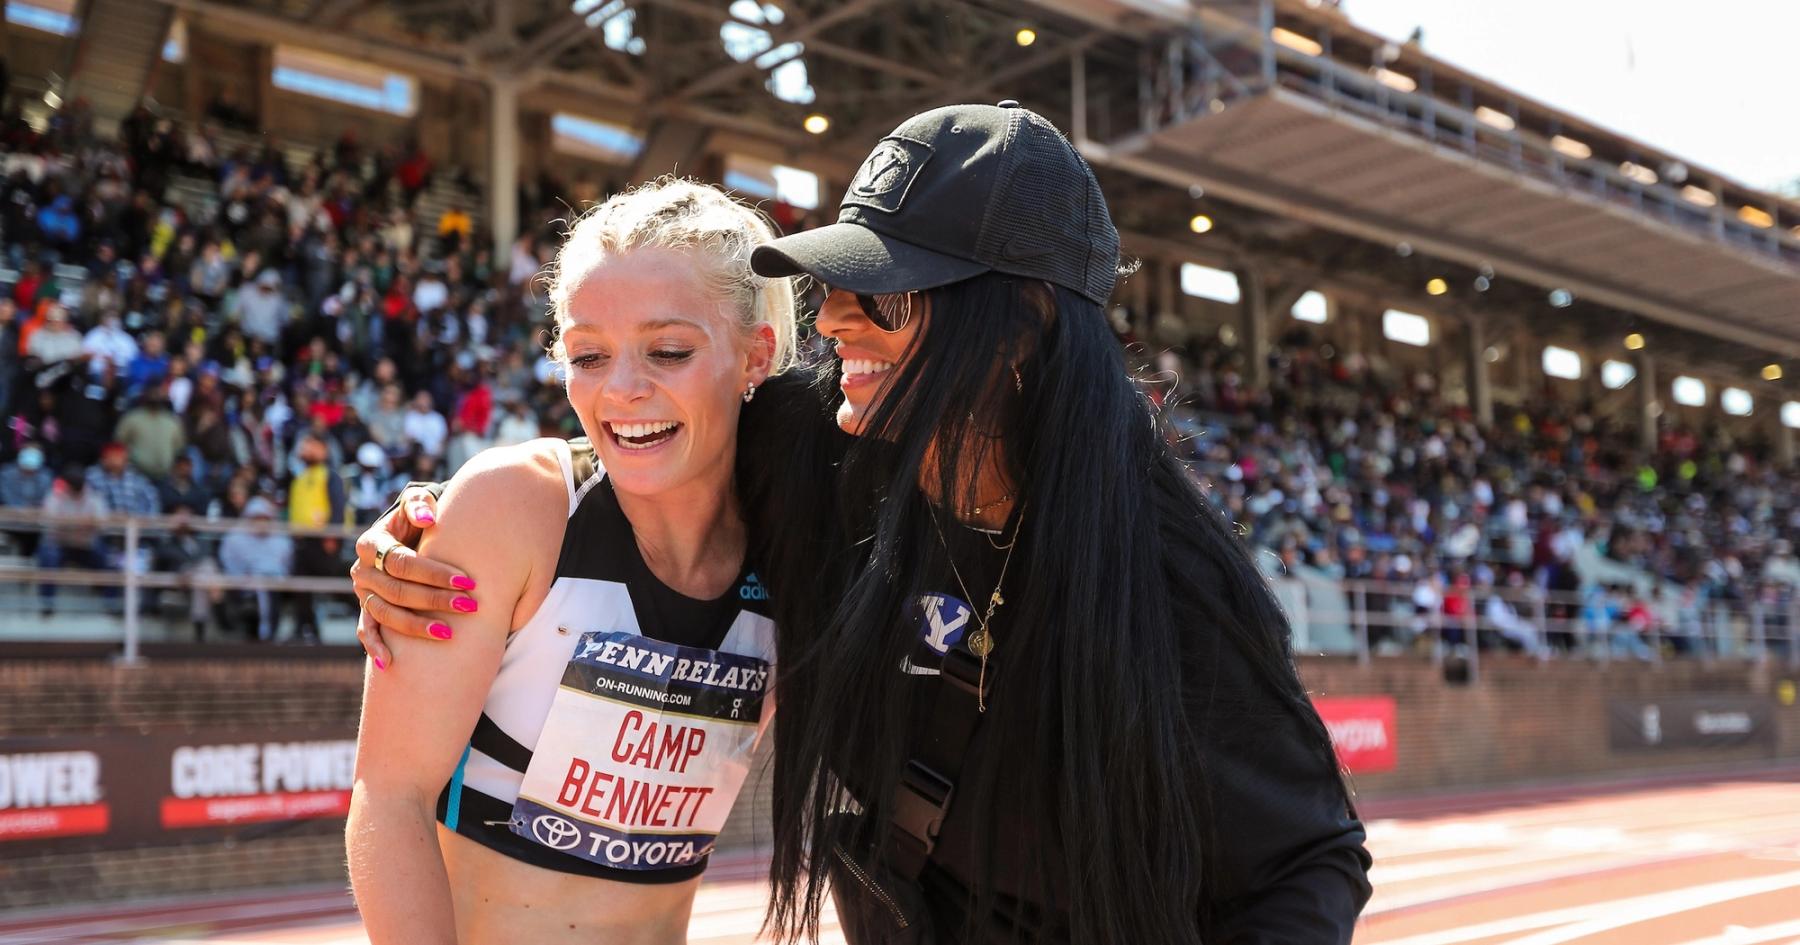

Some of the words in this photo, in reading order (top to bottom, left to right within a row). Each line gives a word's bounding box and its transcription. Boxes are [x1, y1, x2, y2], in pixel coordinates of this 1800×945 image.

[740, 583, 769, 600] adi
[920, 596, 971, 653] Y
[575, 640, 675, 677] PENN
[671, 657, 767, 692] RELAYS
[596, 677, 692, 706] ON-RUNNING.COM
[611, 710, 706, 774] CAMP
[1327, 718, 1388, 752] YOTA
[0, 751, 99, 809] OWER
[172, 743, 260, 799] CORE
[263, 740, 357, 794] POWE
[557, 757, 714, 828] BENNETT
[588, 832, 695, 865] TOYOTA
